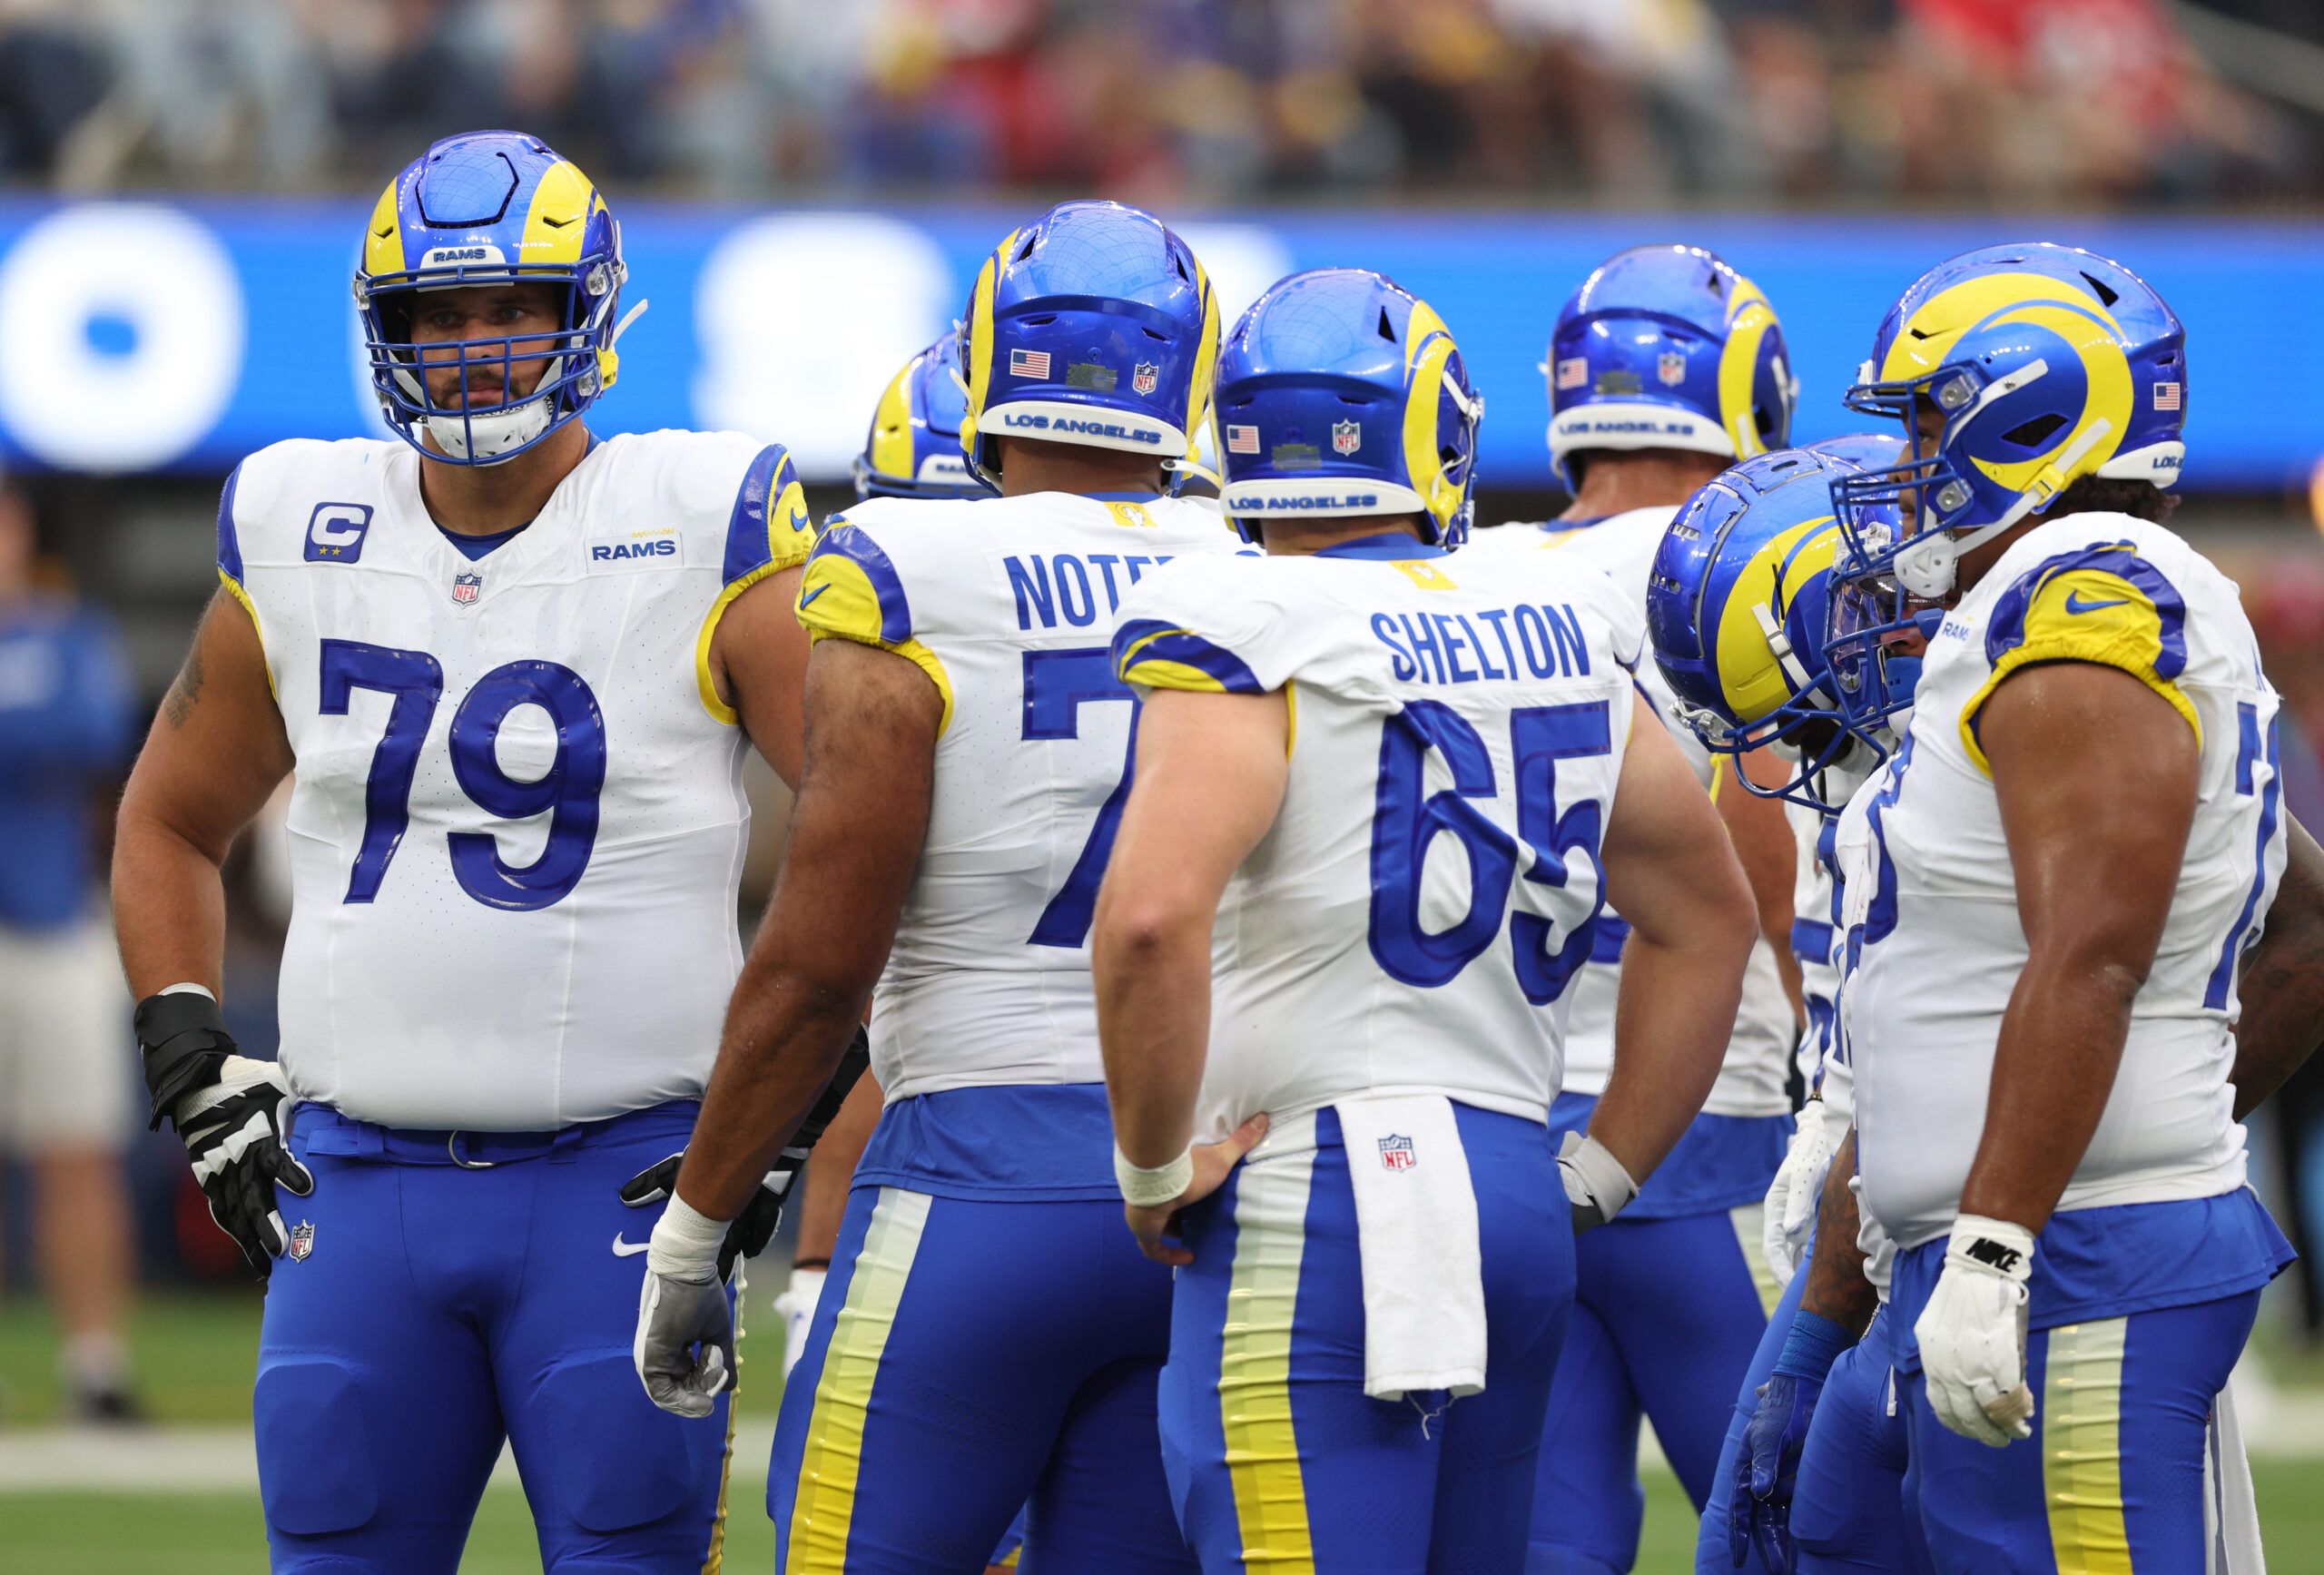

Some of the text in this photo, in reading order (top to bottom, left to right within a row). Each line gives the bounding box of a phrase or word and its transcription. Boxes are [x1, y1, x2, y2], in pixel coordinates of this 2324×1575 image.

[433, 248, 487, 262] RAMS
[1137, 376, 1154, 390] NFL
[1004, 414, 1162, 445] LOS ANGELES
[1337, 435, 1357, 450] NFL
[1228, 495, 1378, 510] LOS ANGELES
[310, 505, 366, 546] C
[592, 539, 676, 561] RAMS
[455, 586, 477, 601] NFL
[1371, 604, 1590, 684] SHELTON
[319, 638, 607, 911] 79
[1368, 698, 1612, 1006] 65
[1384, 1151, 1413, 1168] NFL
[292, 1239, 308, 1255] NFL
[1965, 1237, 2023, 1273] NIKE
